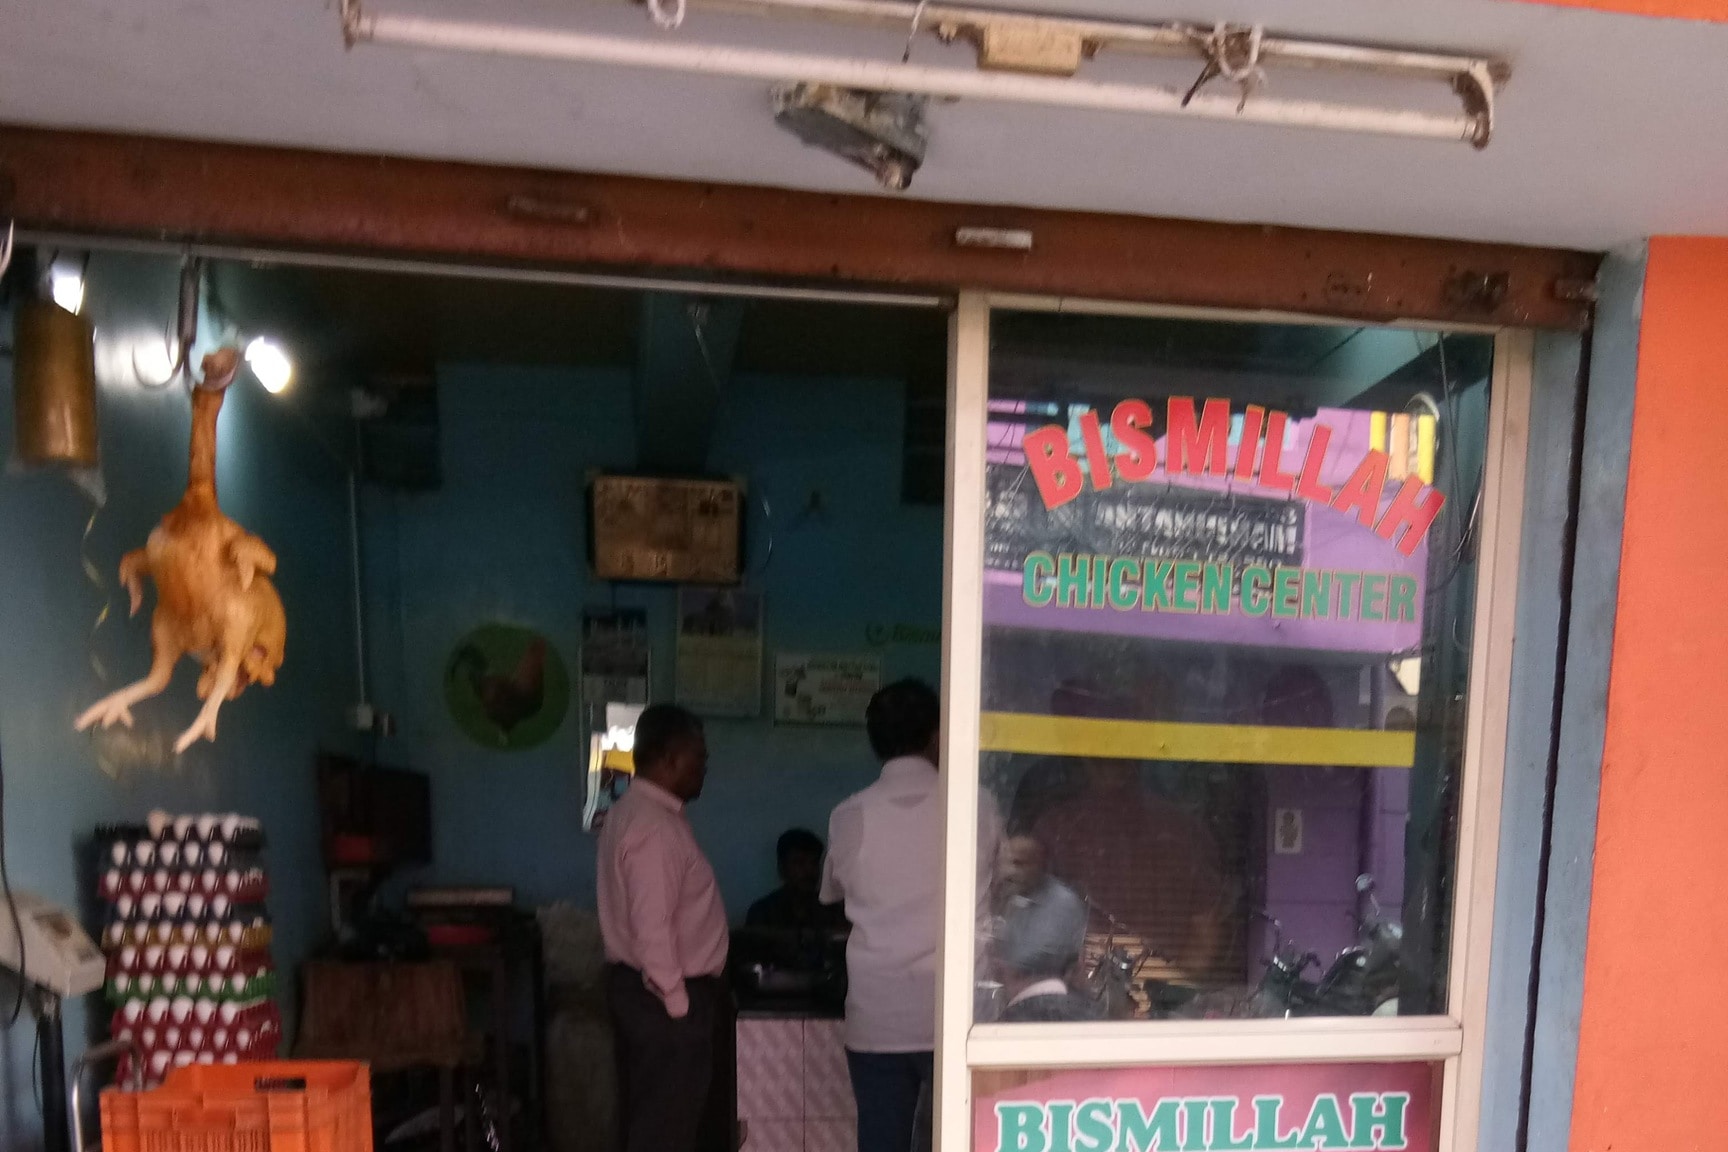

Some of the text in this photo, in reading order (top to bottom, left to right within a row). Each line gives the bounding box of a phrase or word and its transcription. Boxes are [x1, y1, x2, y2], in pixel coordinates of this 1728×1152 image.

[1024, 397, 1445, 556] BISMILLAH
[1023, 552, 1417, 622] CHICKEN CENTER
